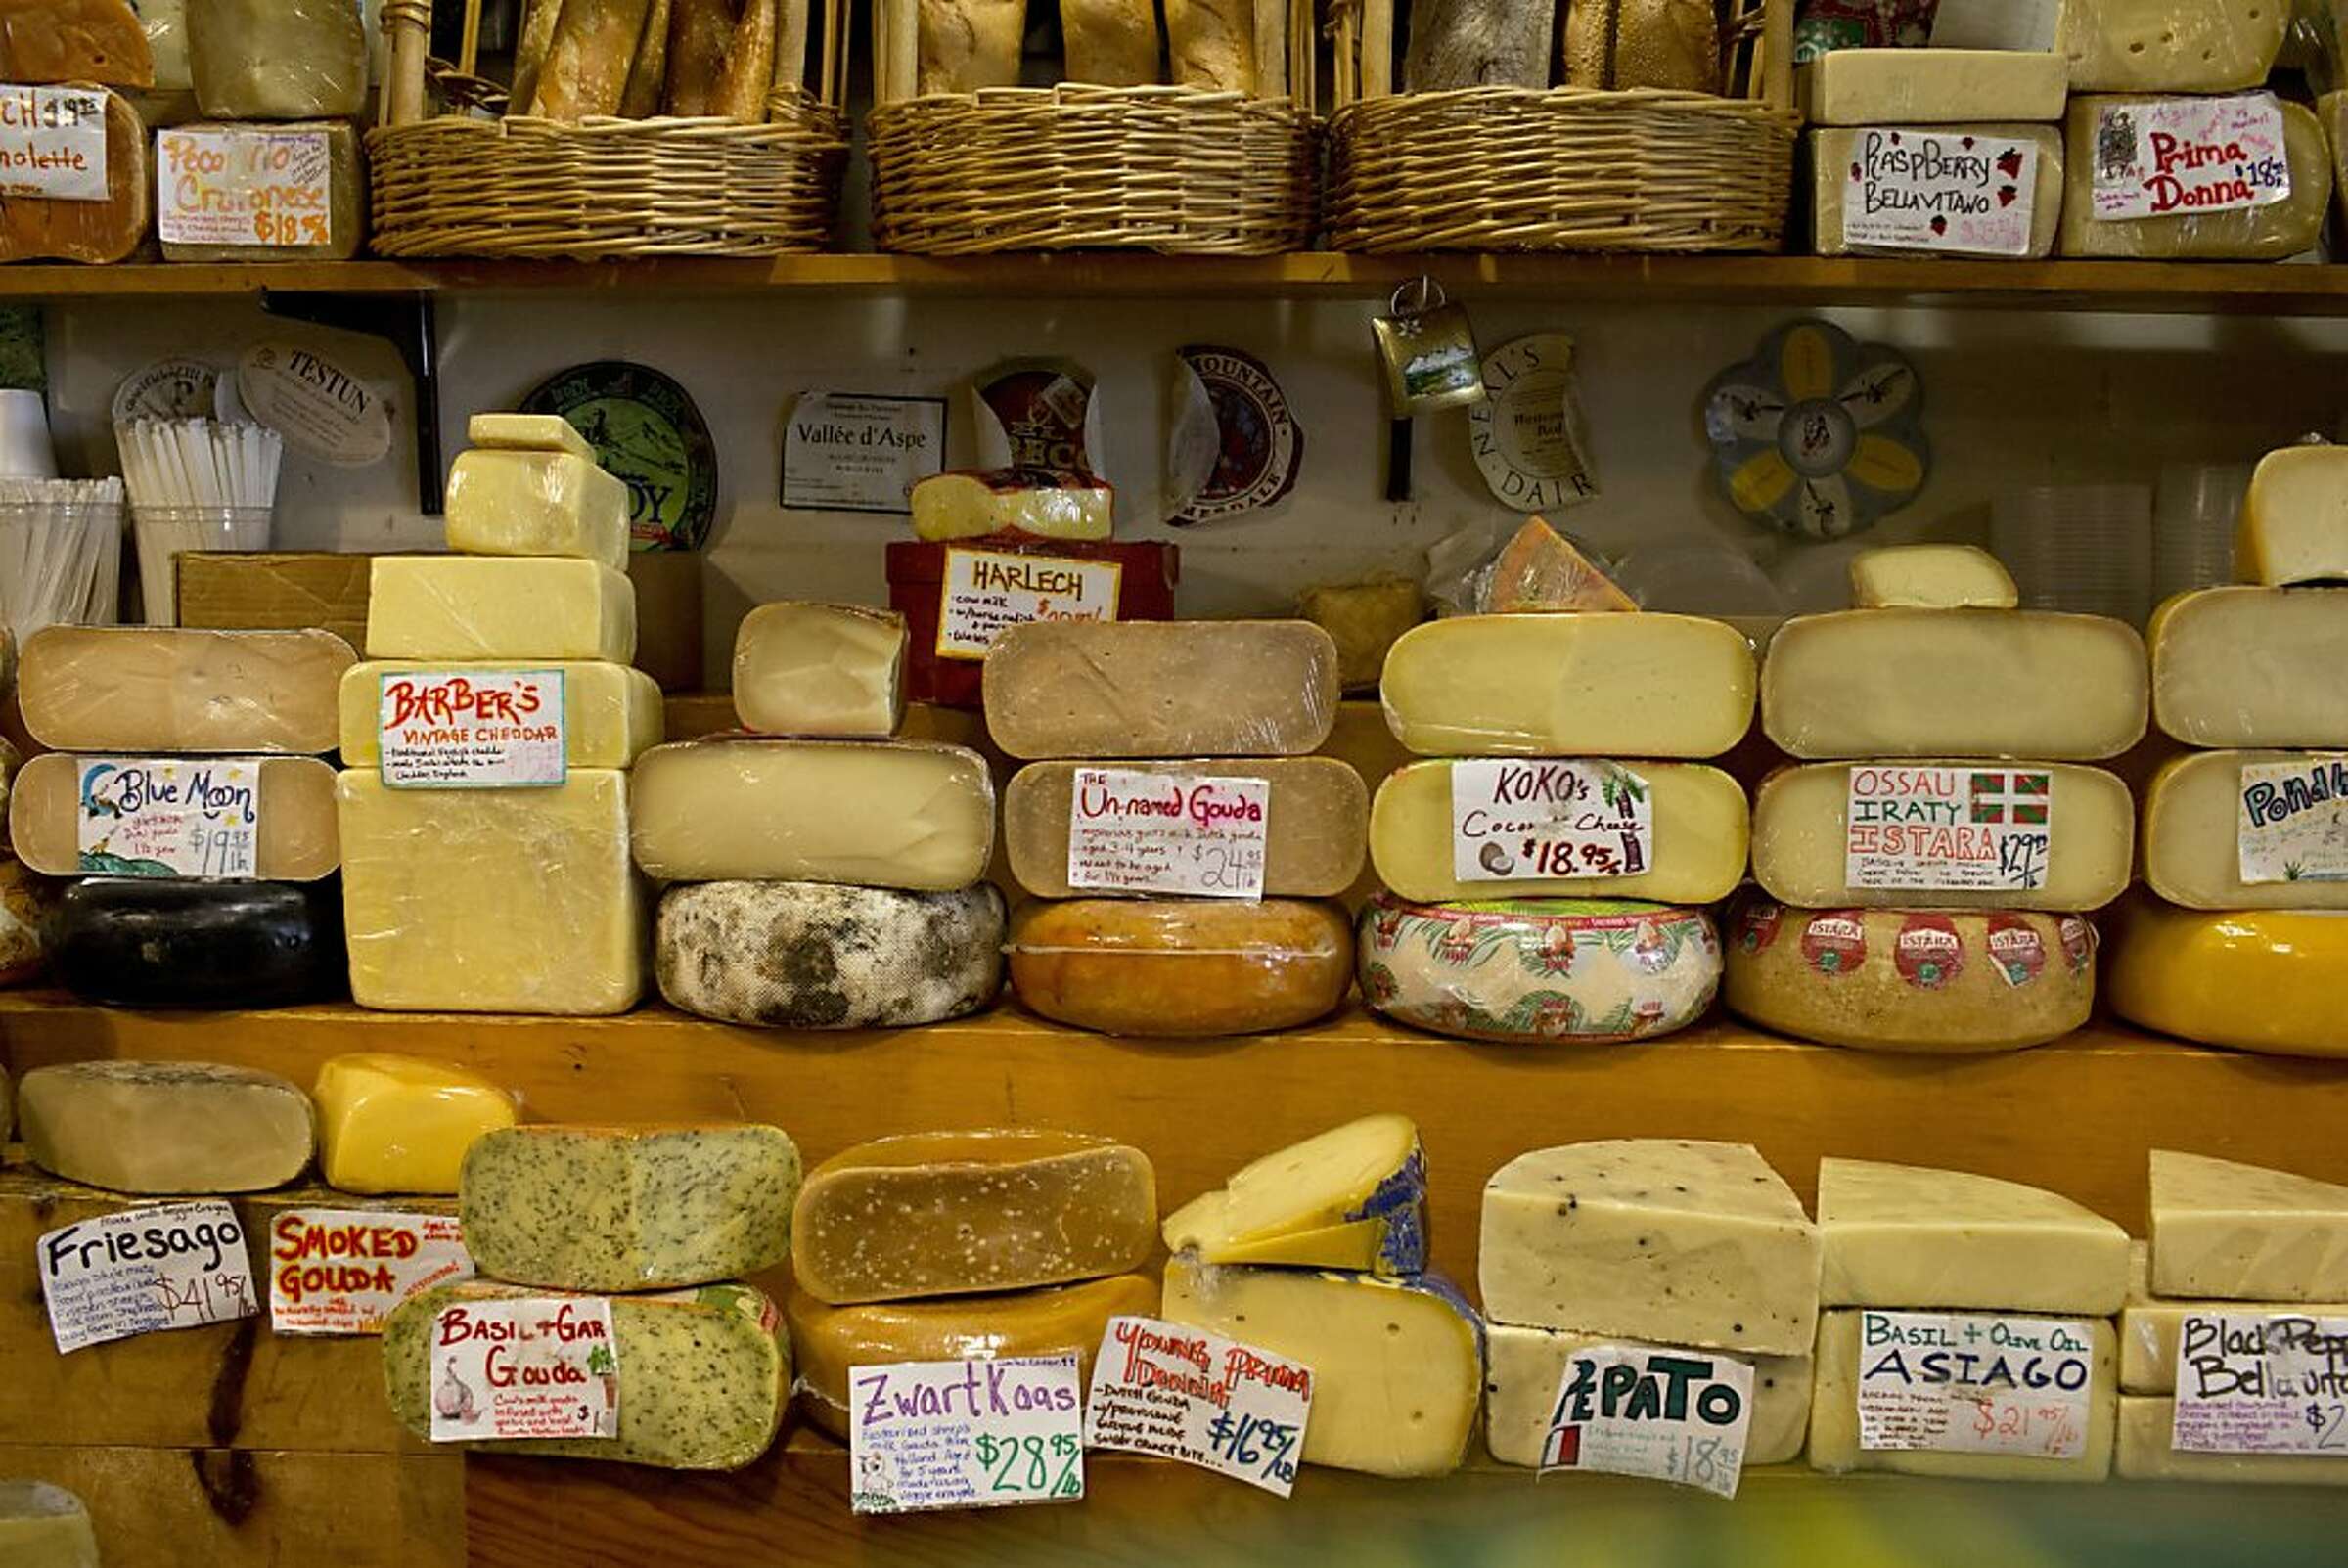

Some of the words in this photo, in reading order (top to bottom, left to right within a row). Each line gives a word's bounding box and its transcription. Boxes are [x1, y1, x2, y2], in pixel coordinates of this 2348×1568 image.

[1, 89, 38, 128] CH
[2148, 131, 2248, 174] Prima
[2143, 173, 2255, 212] Donna
[289, 349, 368, 415] TESTUN
[797, 423, 855, 444] Vallée
[860, 425, 927, 453] d'Aspe
[1501, 470, 1593, 507] DAIR
[972, 560, 1084, 602] HARLECH
[384, 678, 541, 731] BARBER'S
[402, 728, 470, 746] VINTAGE
[475, 725, 559, 744] CHEDDAR
[113, 768, 179, 813] Blue
[185, 769, 256, 825] Moon
[1492, 764, 1591, 805] KOKO's
[1854, 769, 1956, 797] OSSAU
[1188, 784, 1263, 828] Gouda
[1854, 800, 1962, 827] IRATY
[1849, 824, 1997, 862] ISTARA
[47, 1222, 241, 1277] Friesago
[274, 1216, 418, 1261] SMOKED
[278, 1264, 396, 1304] GOUDA
[1865, 1313, 1958, 1347] BASIL
[2049, 1328, 2089, 1352] OIL
[486, 1345, 587, 1387] Gouda
[1863, 1348, 2088, 1391] ASIAGO
